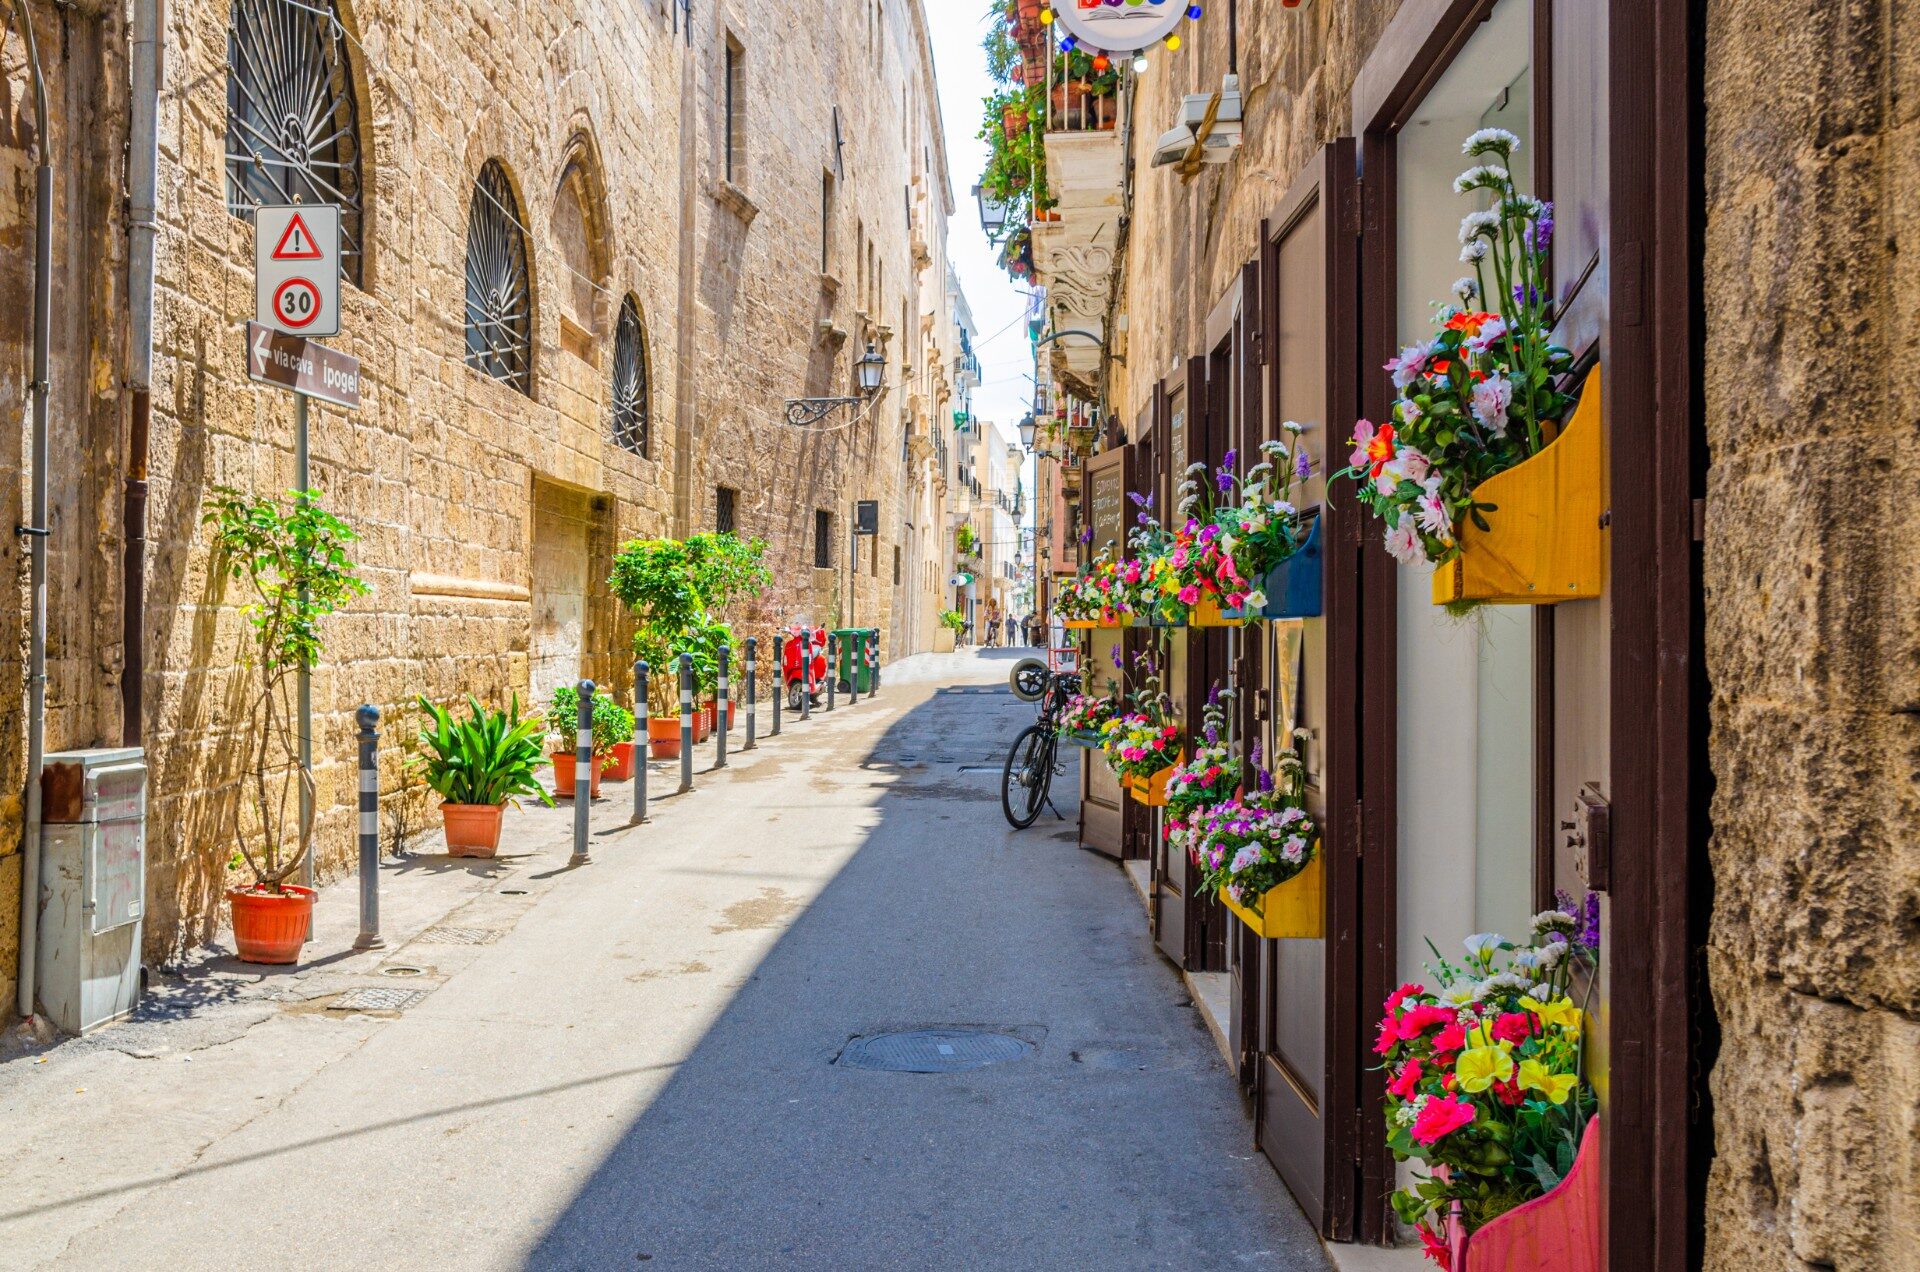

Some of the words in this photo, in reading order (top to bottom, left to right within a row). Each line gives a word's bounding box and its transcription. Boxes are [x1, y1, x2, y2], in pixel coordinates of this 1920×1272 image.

[284, 291, 311, 315] 30
[273, 346, 289, 368] via
[290, 354, 314, 376] cava
[323, 359, 358, 394] ipogei
